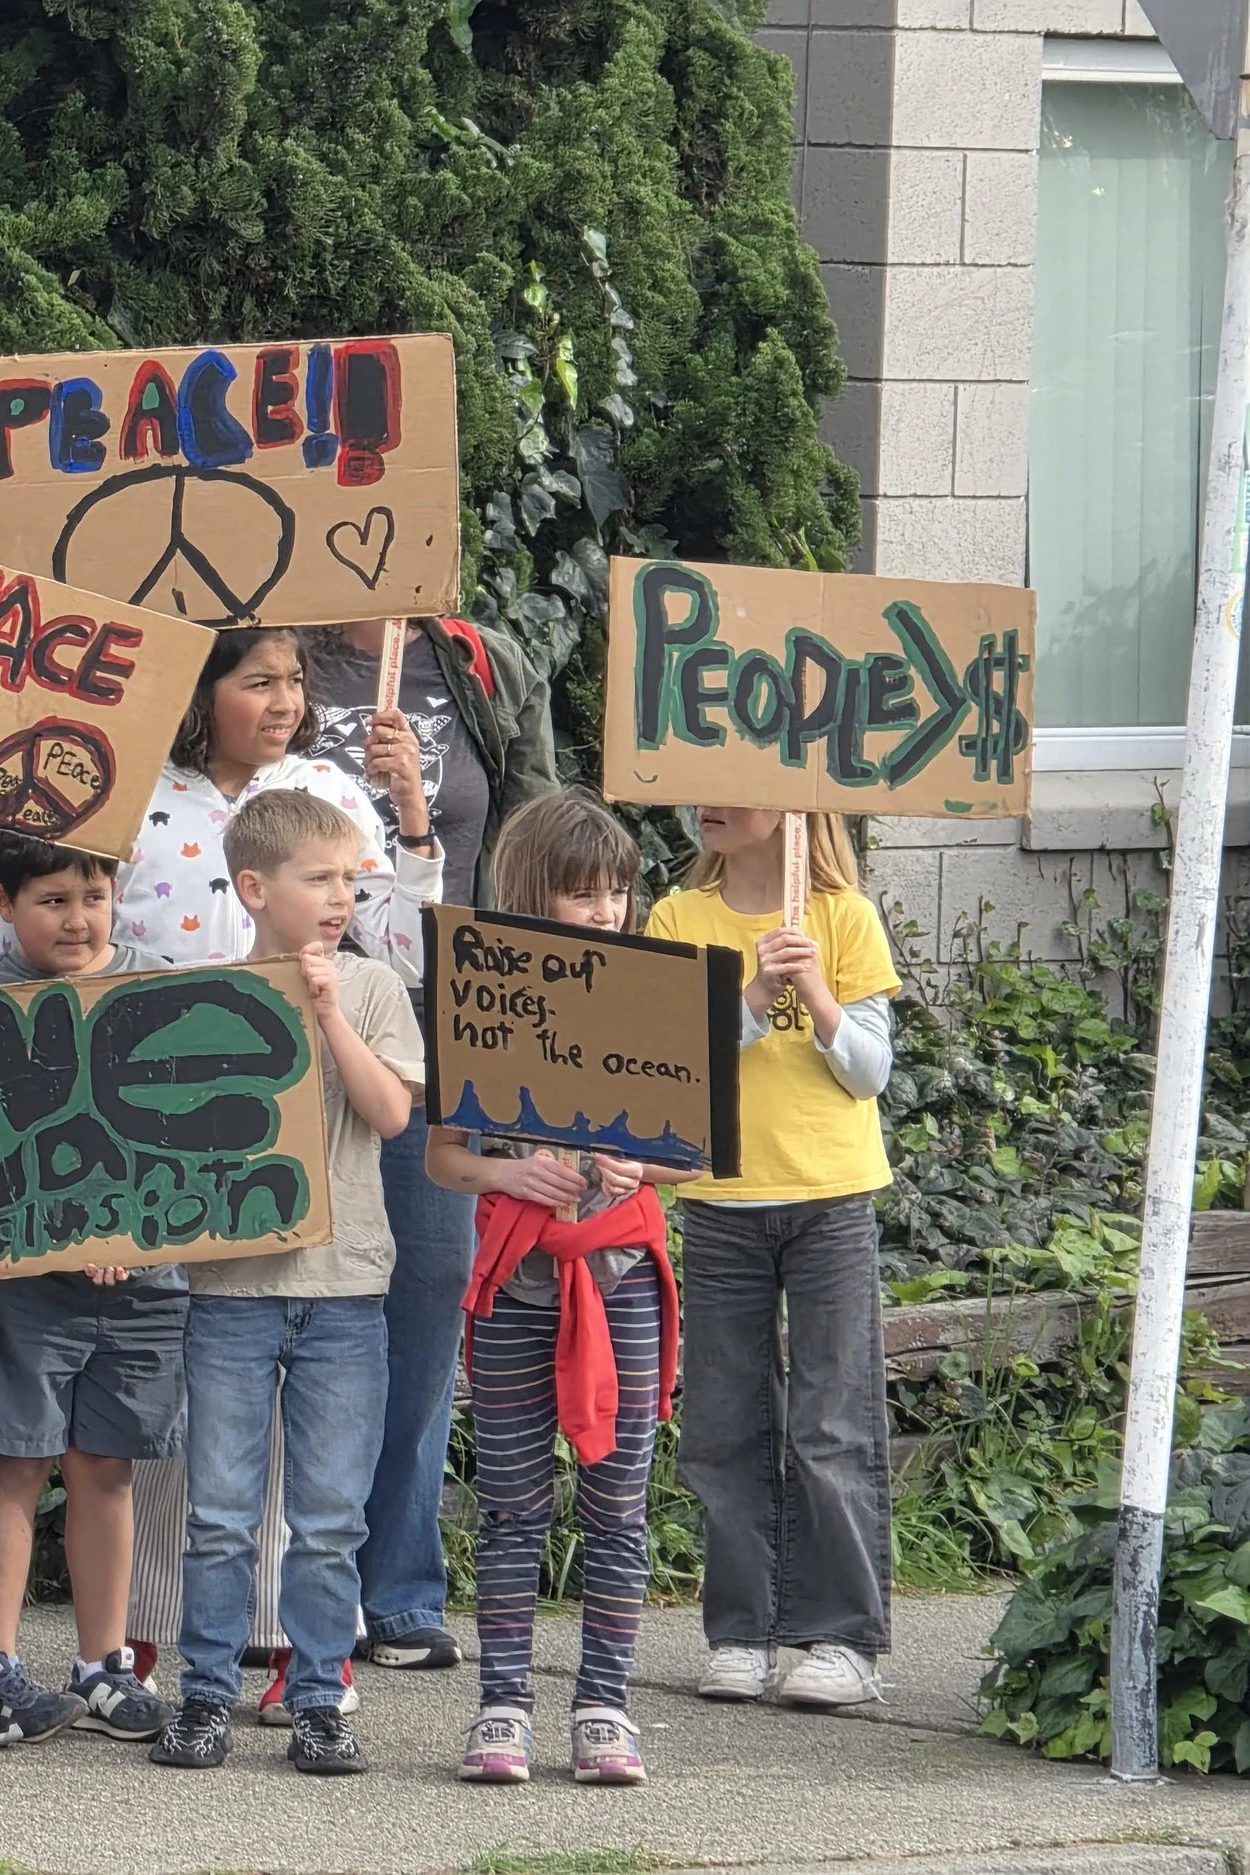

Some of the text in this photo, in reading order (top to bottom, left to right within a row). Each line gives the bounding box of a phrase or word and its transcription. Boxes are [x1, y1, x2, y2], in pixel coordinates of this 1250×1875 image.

[453, 925, 532, 976] Raise
[454, 1014, 514, 1050] not
[536, 1028, 583, 1070] the
